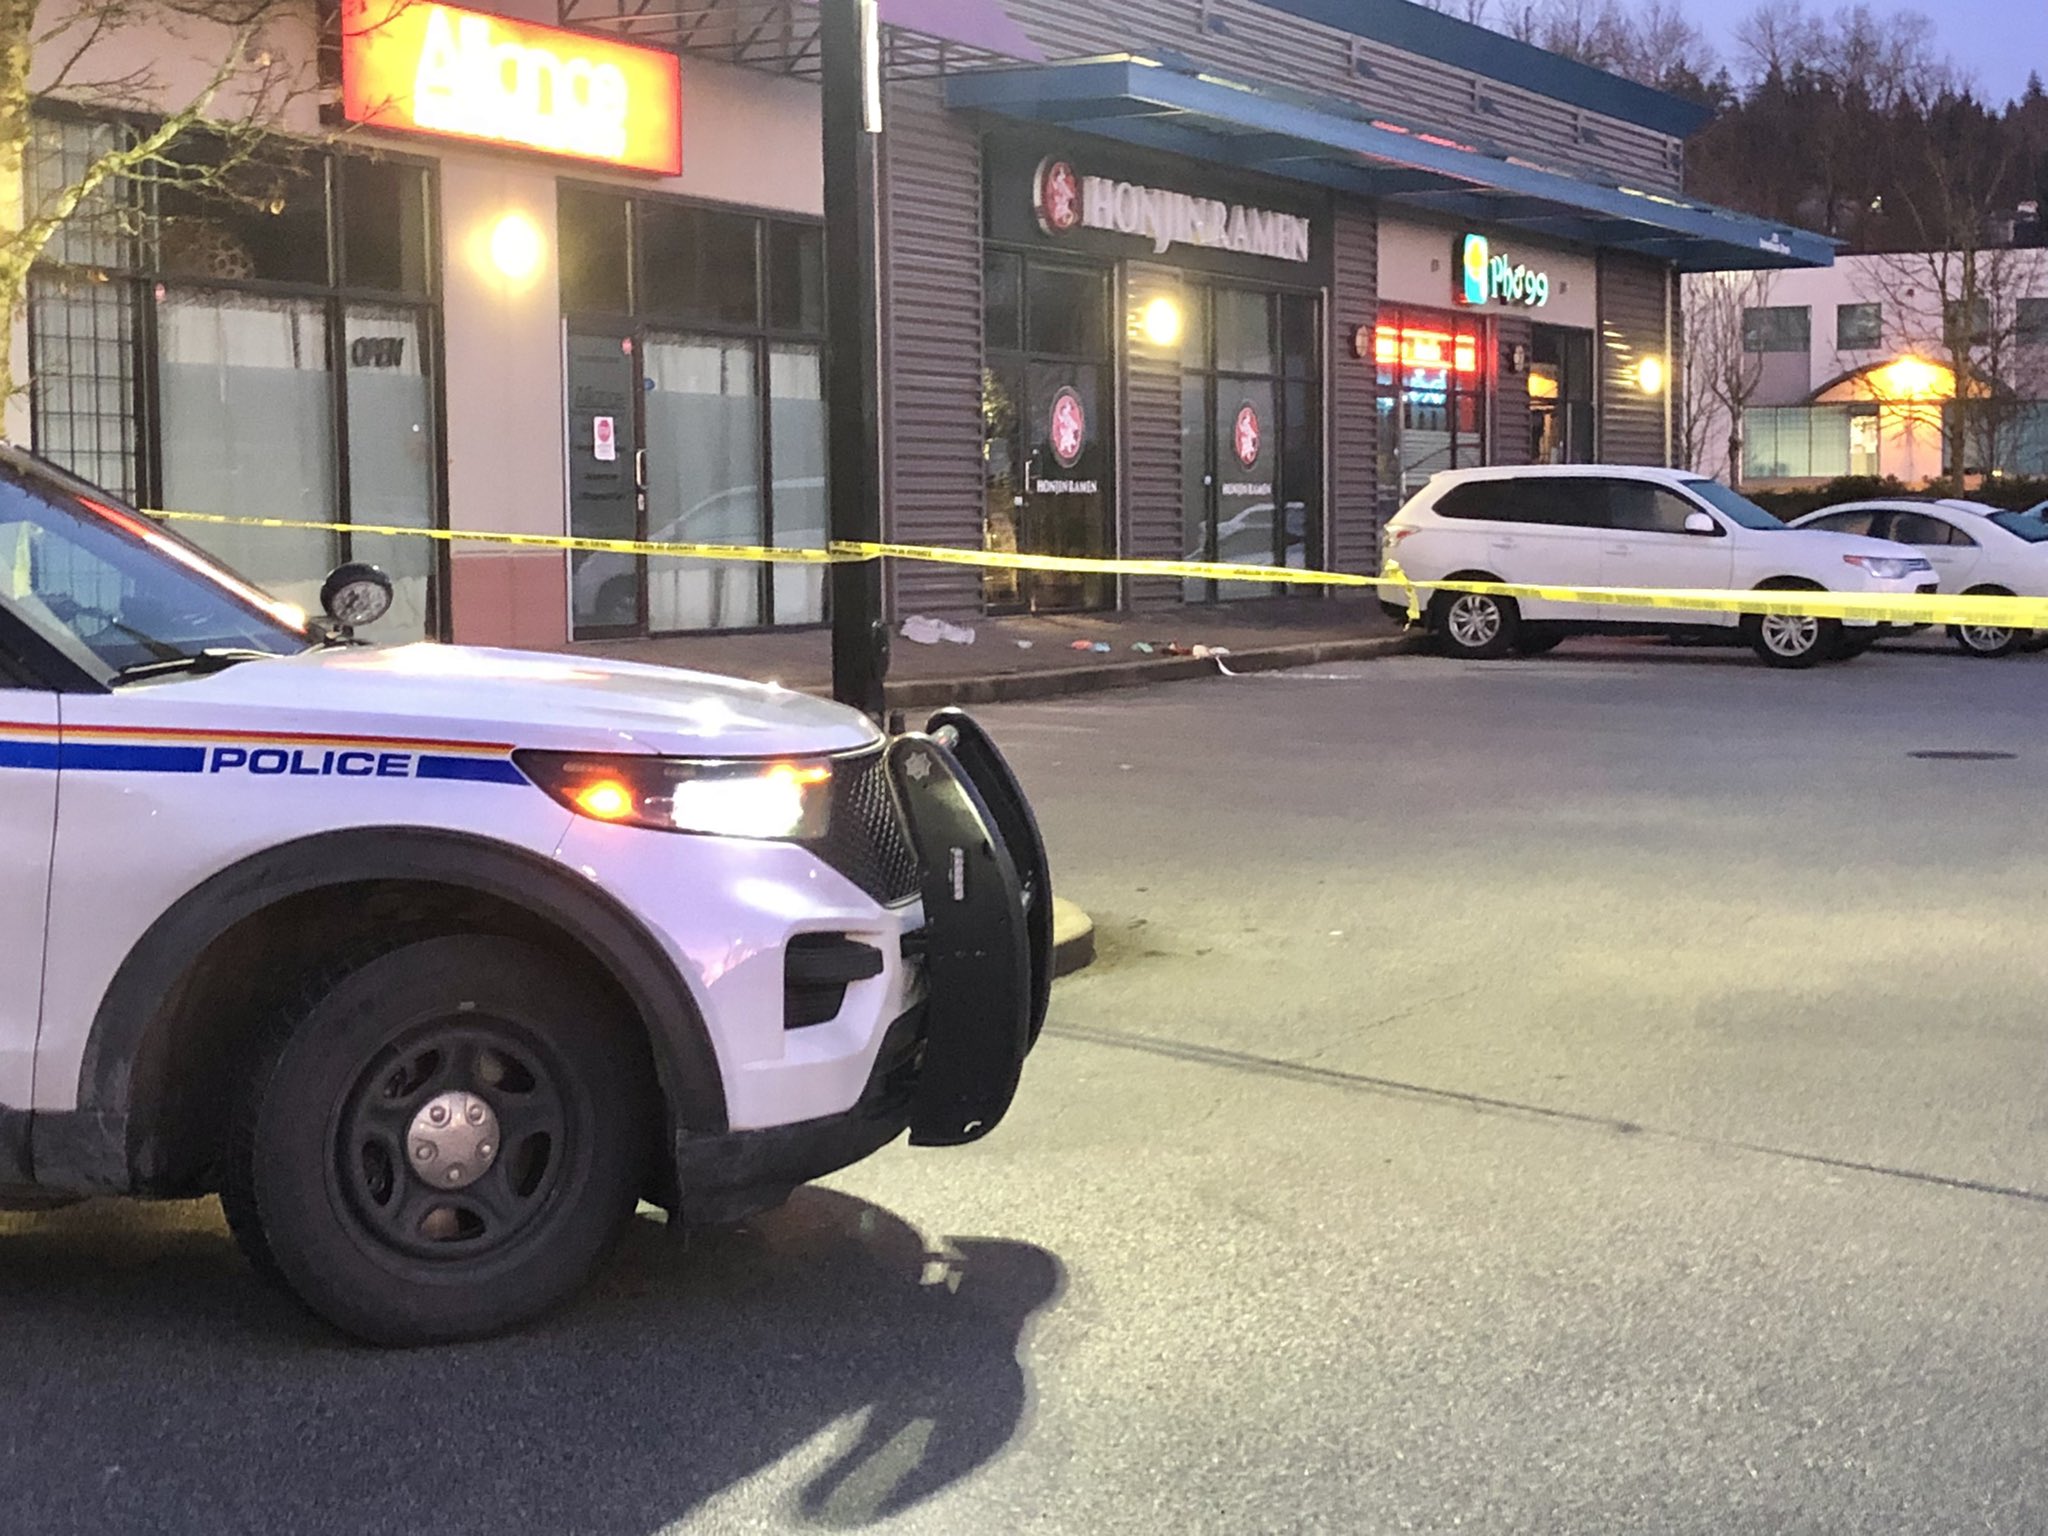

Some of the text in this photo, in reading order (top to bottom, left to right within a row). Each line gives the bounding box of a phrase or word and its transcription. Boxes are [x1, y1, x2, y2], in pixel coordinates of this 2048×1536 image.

[1082, 176, 1310, 263] HONJIN RAMEN
[209, 746, 413, 777] POLICE
